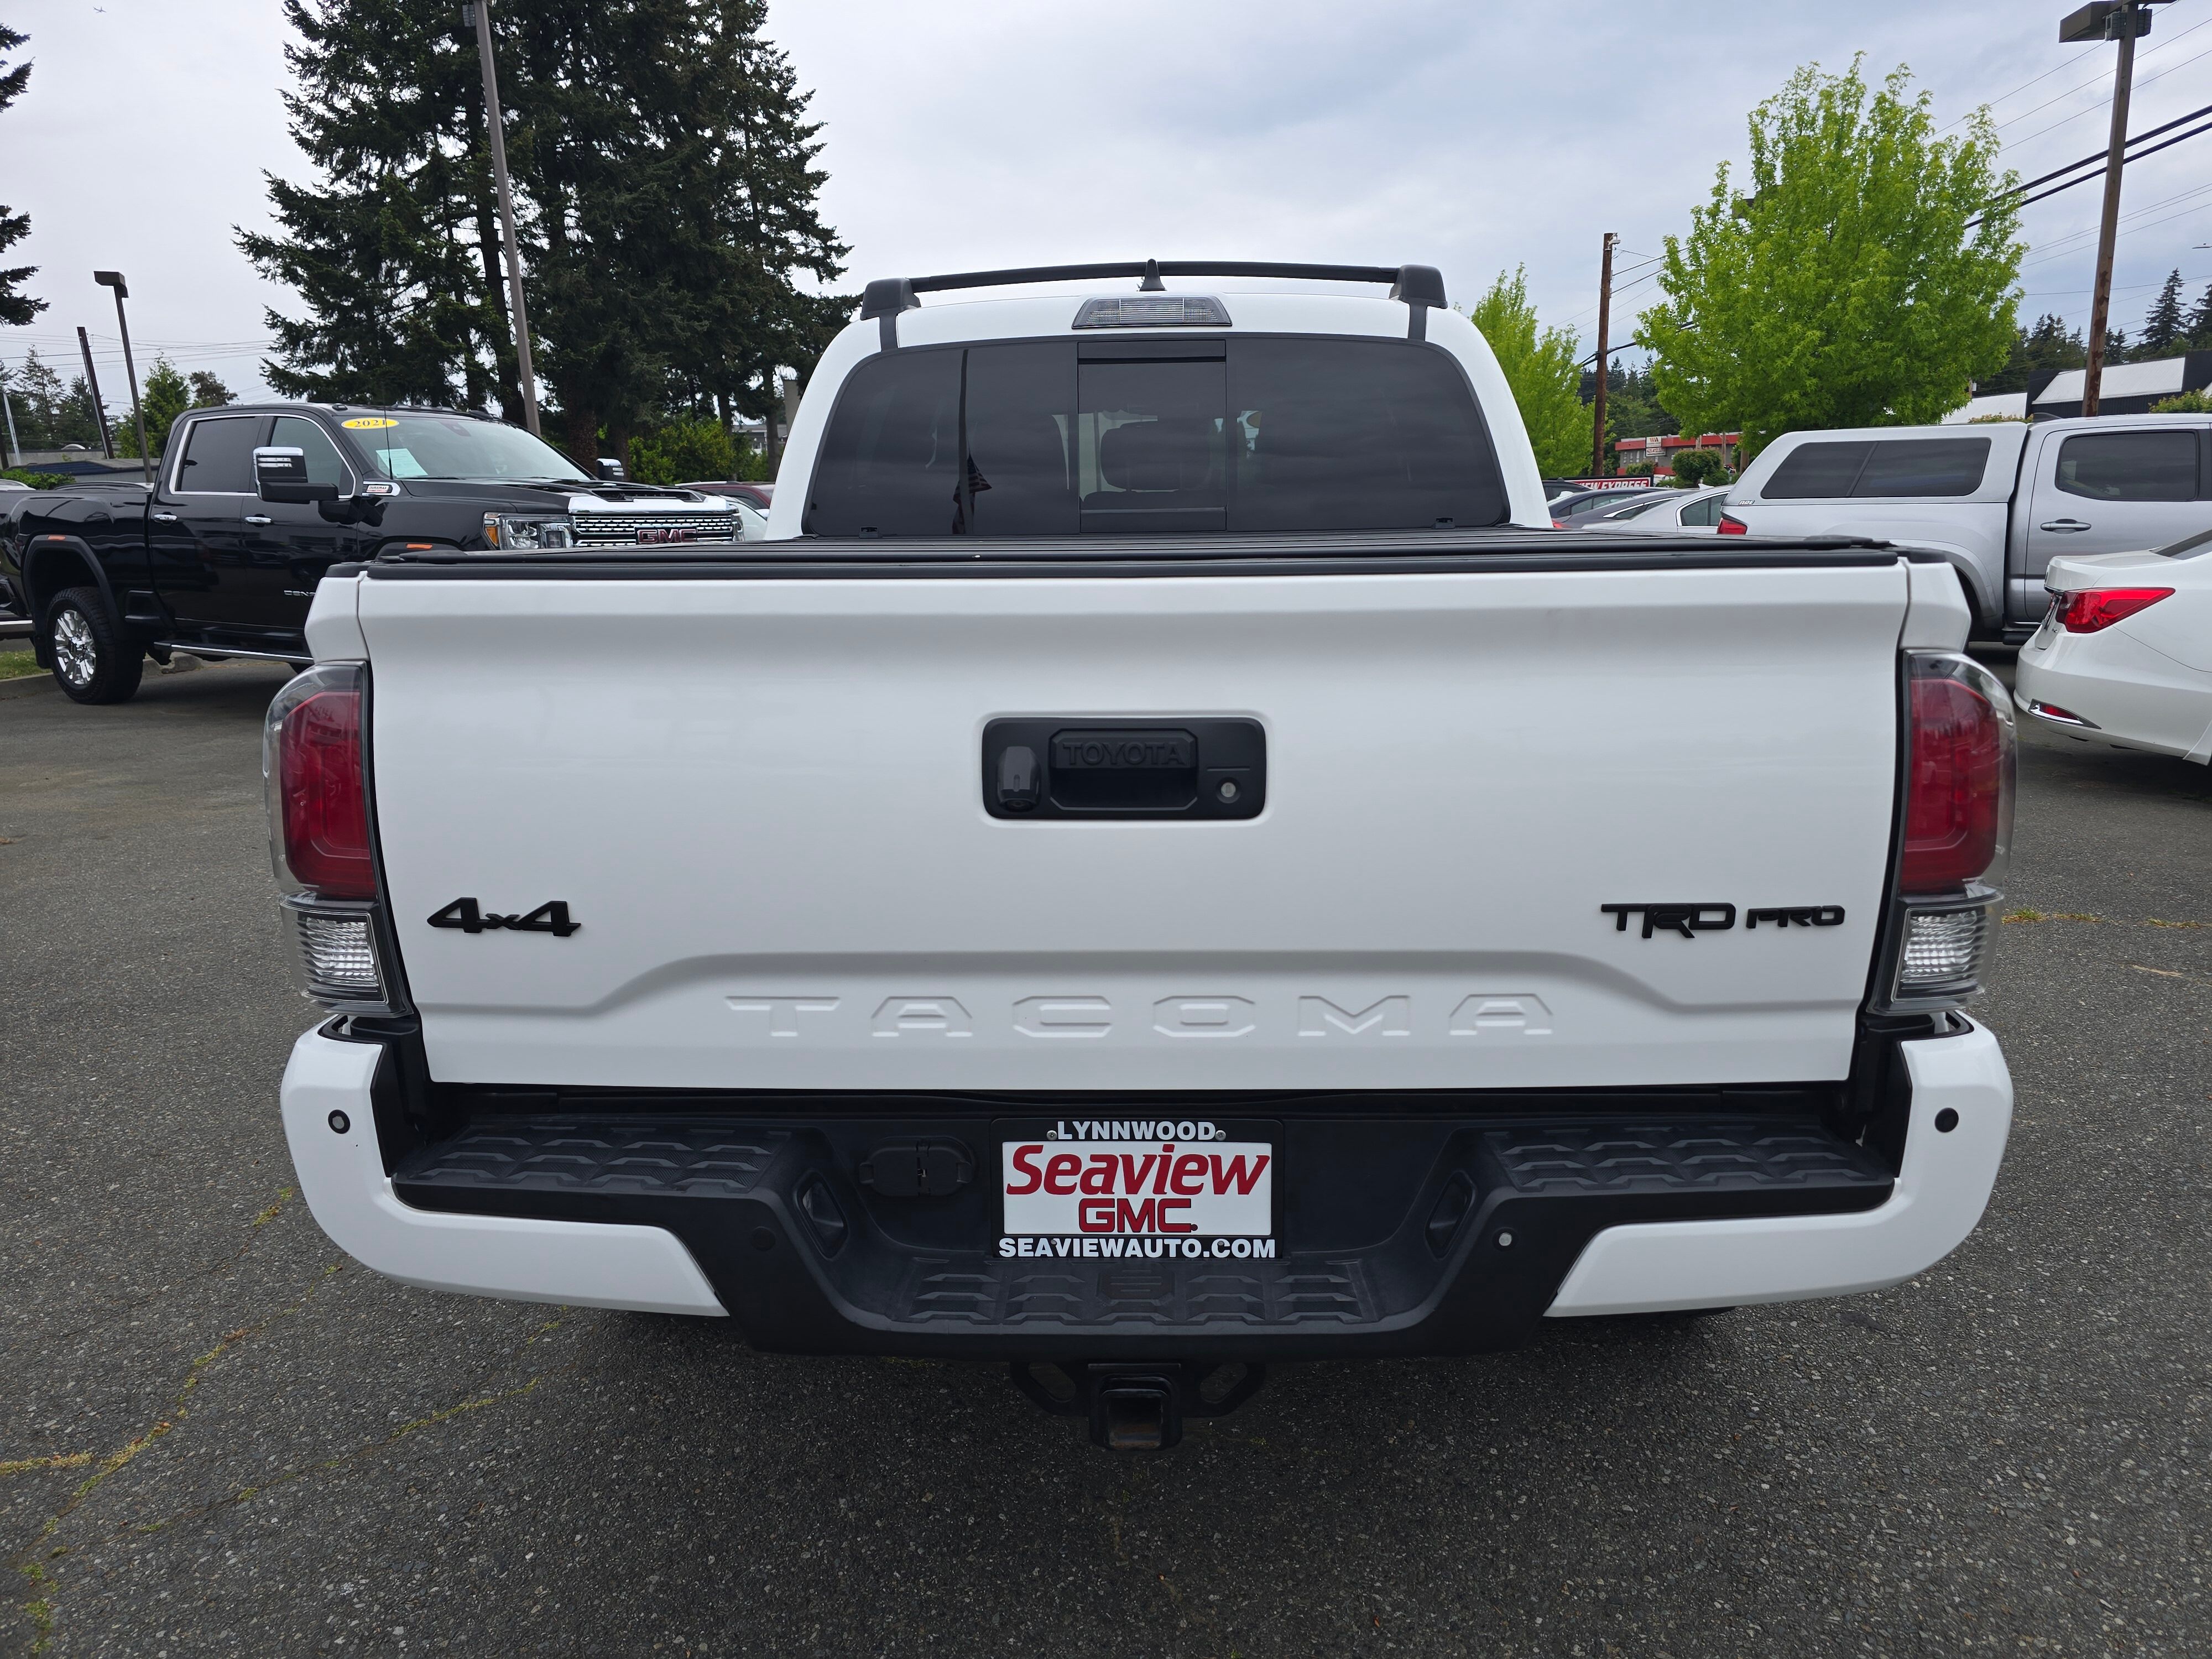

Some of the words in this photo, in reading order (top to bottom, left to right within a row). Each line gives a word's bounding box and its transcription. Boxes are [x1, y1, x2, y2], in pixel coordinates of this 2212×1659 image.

[637, 529, 697, 544] GMC
[1062, 741, 1186, 766] TOYOTA
[426, 896, 581, 937] 4x4
[1601, 902, 1736, 939] TRD
[1746, 905, 1845, 929] PRO
[724, 994, 1553, 1037] TACOMA
[1057, 1121, 1216, 1140] LYNNWOOD
[1006, 1144, 1270, 1195] Seaview
[999, 1238, 1275, 1258] SEAVIEWAUTO.COM
